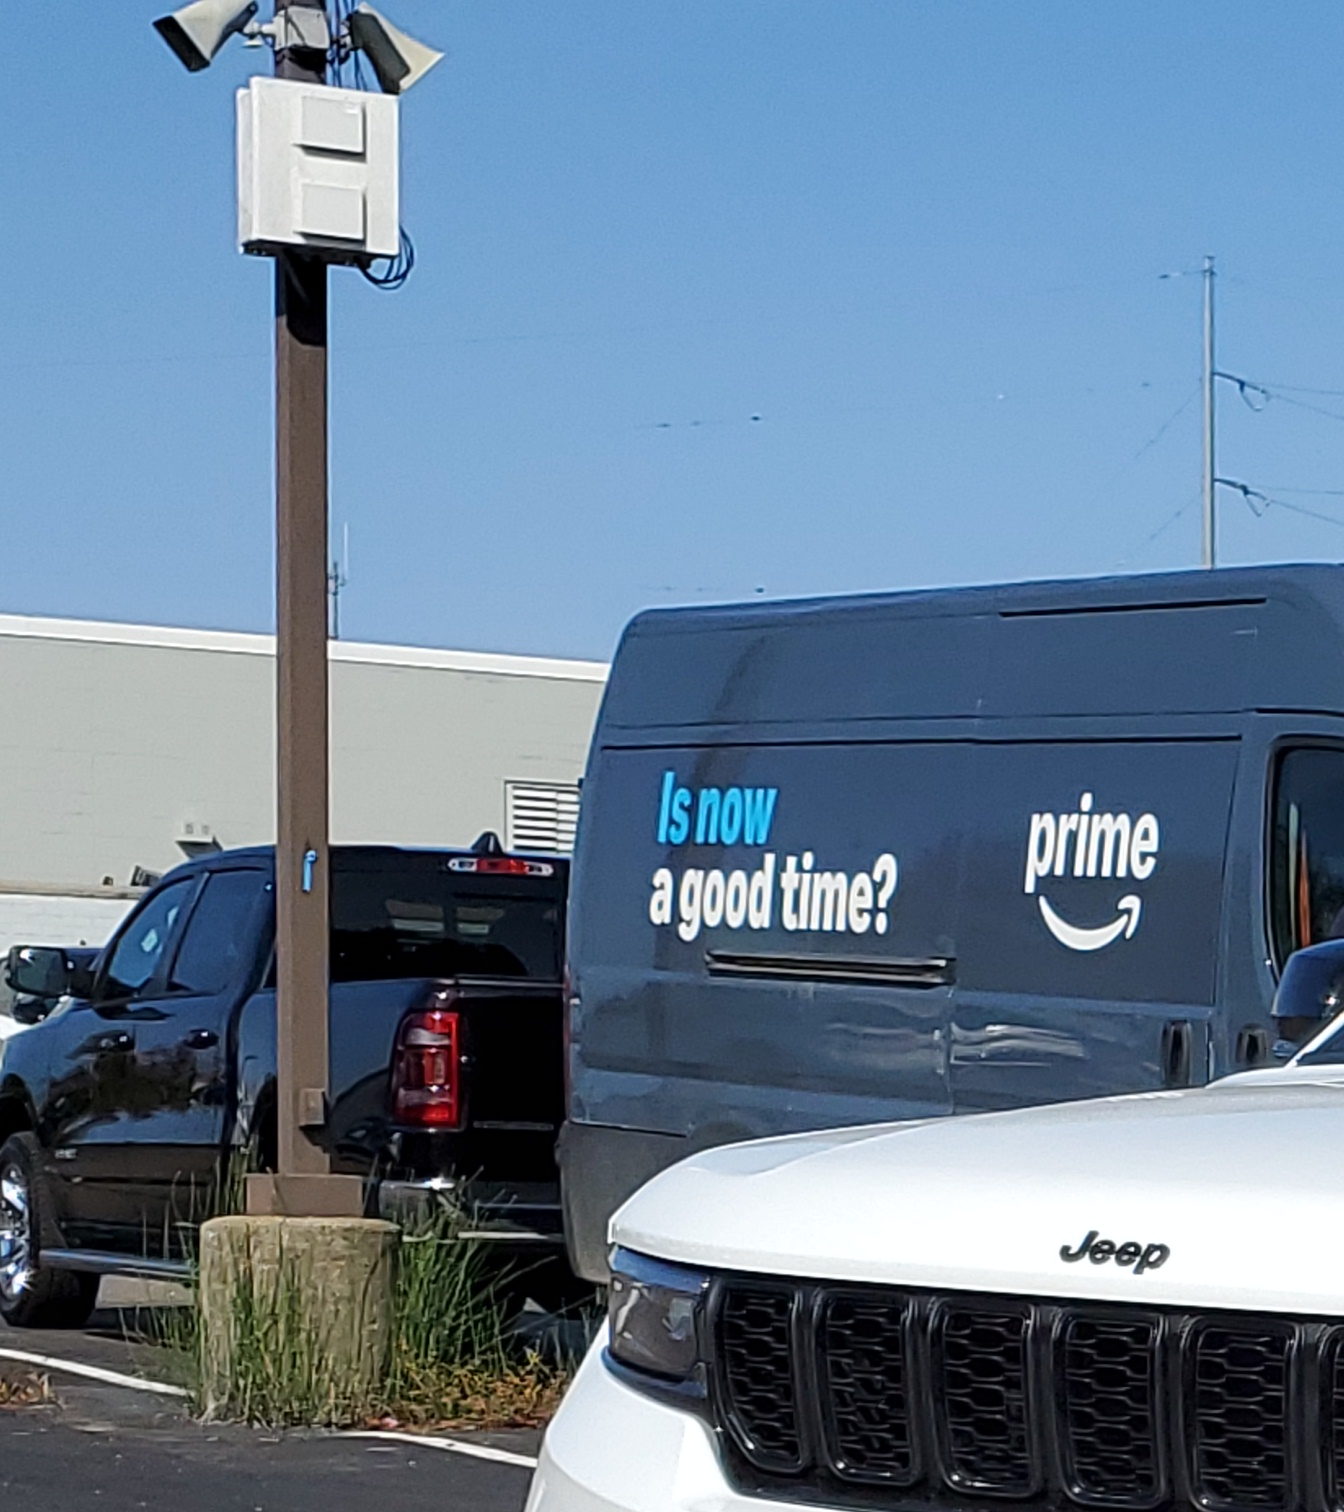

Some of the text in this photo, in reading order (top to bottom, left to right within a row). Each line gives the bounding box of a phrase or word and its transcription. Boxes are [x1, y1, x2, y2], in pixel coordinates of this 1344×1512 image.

[657, 771, 779, 845] Is now
[1024, 792, 1159, 893] prime
[650, 851, 898, 942] a good time?
[1059, 1230, 1170, 1275] Jeep
